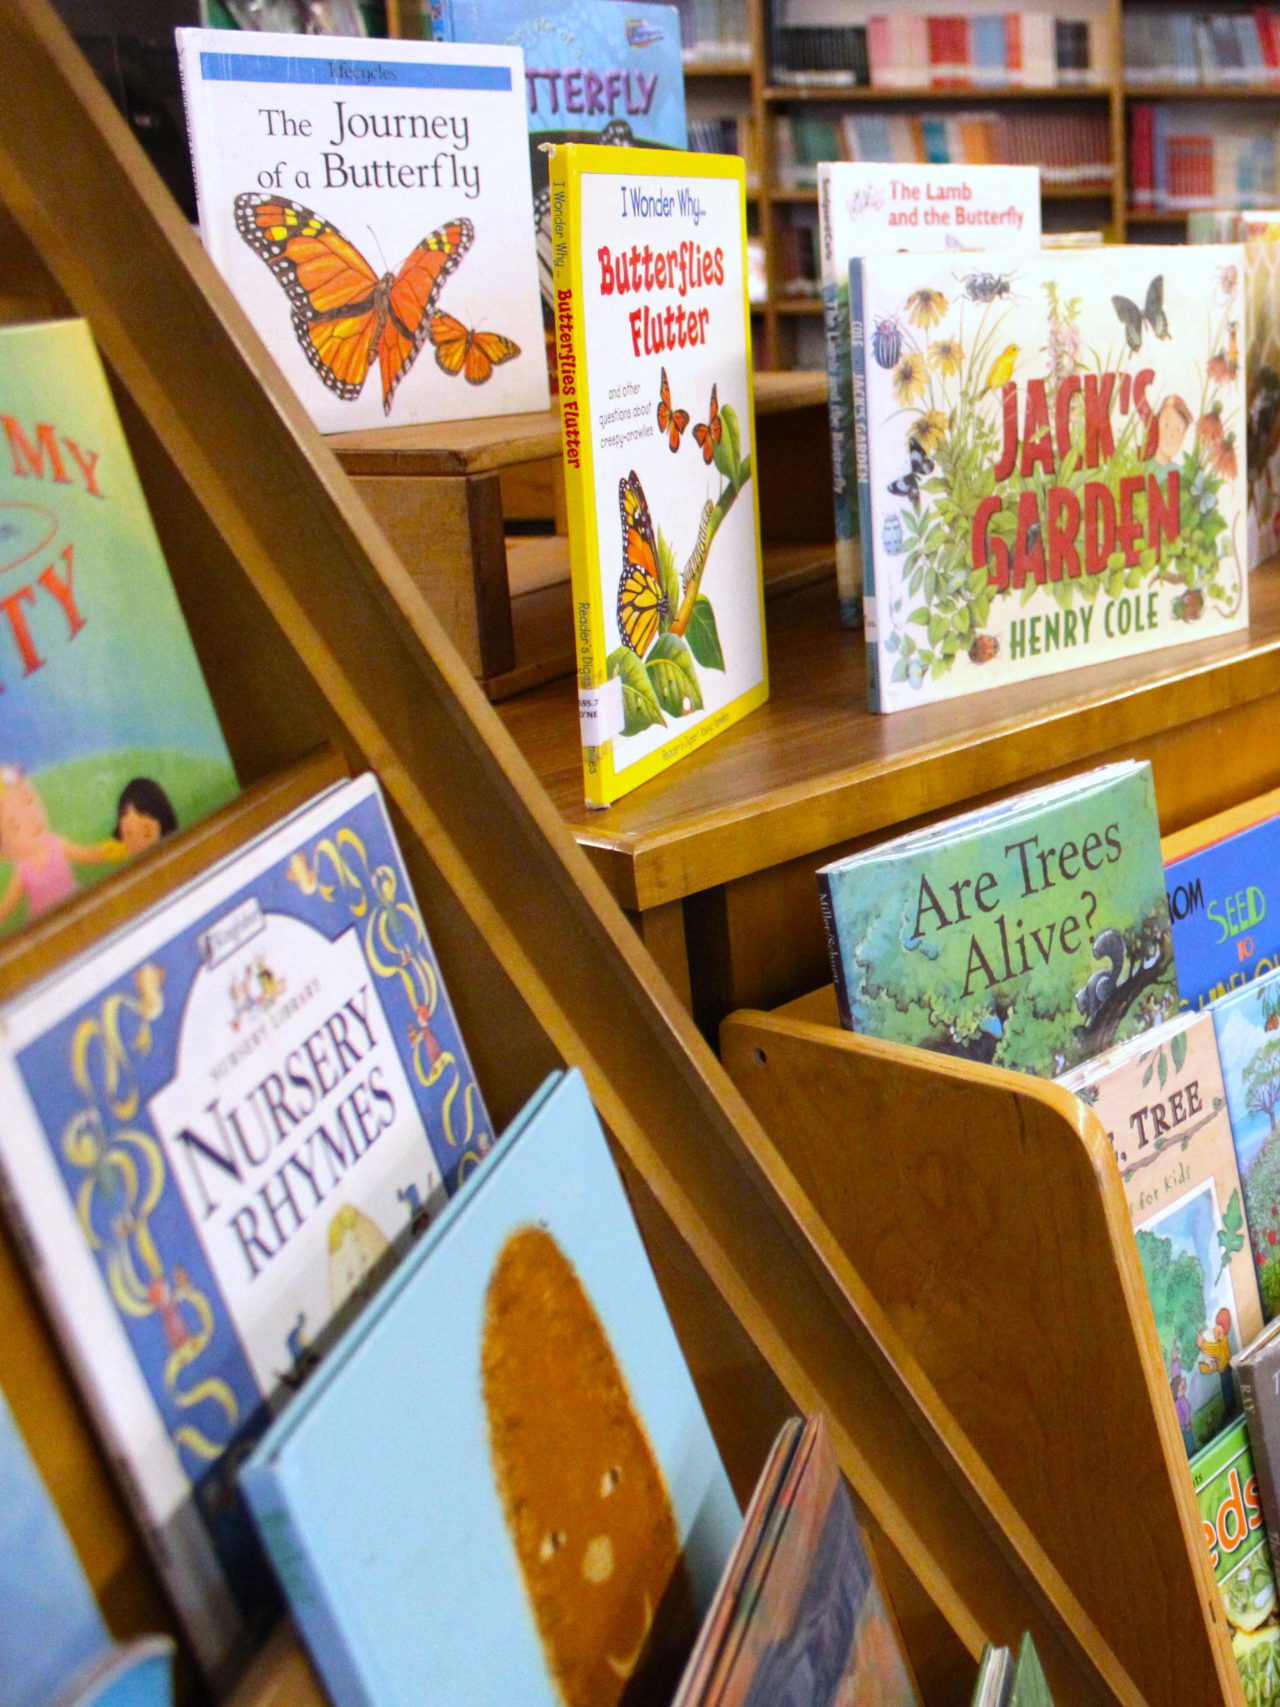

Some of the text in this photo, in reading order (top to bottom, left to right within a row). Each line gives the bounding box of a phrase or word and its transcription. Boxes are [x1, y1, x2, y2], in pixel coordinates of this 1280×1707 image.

[525, 66, 658, 116] TTERFLY
[258, 102, 470, 151] The Journey
[257, 152, 481, 199] of a Butterfly
[621, 186, 628, 218] I
[630, 187, 675, 218] Wonder
[890, 180, 973, 201] The Lamb
[553, 191, 564, 238] Wonder
[888, 206, 1024, 230] and the Butterfly
[598, 240, 725, 297] Butterflies
[629, 304, 710, 358] Flutter
[557, 289, 580, 469] Butterflies Flutter
[608, 382, 641, 399] and other
[827, 301, 849, 494] The Lamb and the Butterfly
[853, 319, 870, 485] COLE JACK'S GARDEN
[598, 402, 652, 429] questions about
[600, 426, 653, 449] creepy-crawlies
[994, 368, 1160, 483] JACK'S
[0, 414, 105, 499] MY
[971, 470, 1181, 594] GARDEN
[0, 544, 87, 681] TY
[578, 601, 593, 653] Reader's
[1009, 592, 1159, 660] HENRY COLE
[910, 822, 1123, 940] Are Trees
[1167, 878, 1204, 925] OM
[1207, 886, 1267, 945] SEED
[960, 890, 1099, 1000] Alive?
[1237, 935, 1255, 963] TO
[172, 986, 381, 1219] NURSERY
[1130, 1080, 1204, 1150] TREE
[227, 1066, 398, 1281] RHYMES
[1140, 1186, 1159, 1210] for
[1202, 1468, 1263, 1570] eds
